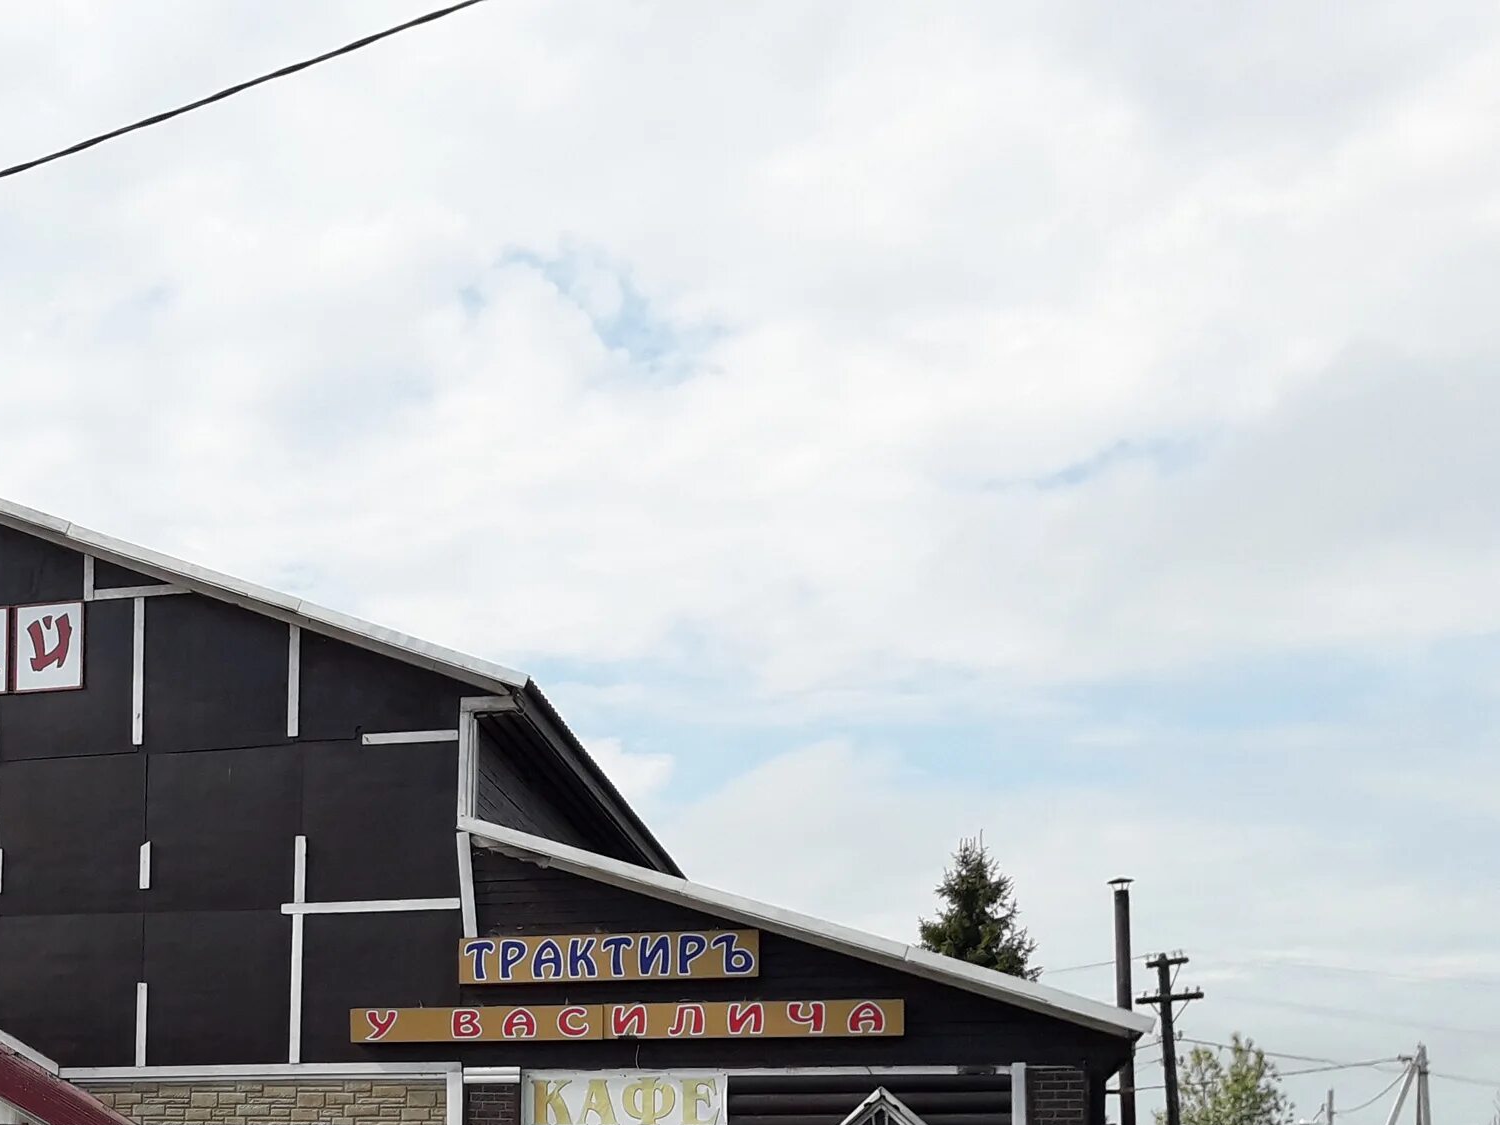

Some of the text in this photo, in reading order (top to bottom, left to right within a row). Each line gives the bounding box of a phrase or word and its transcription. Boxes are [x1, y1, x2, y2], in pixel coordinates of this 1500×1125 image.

[464, 933, 755, 981] ТРАКТИРЪ
[365, 1001, 888, 1040] У ВАСИЛИЧА
